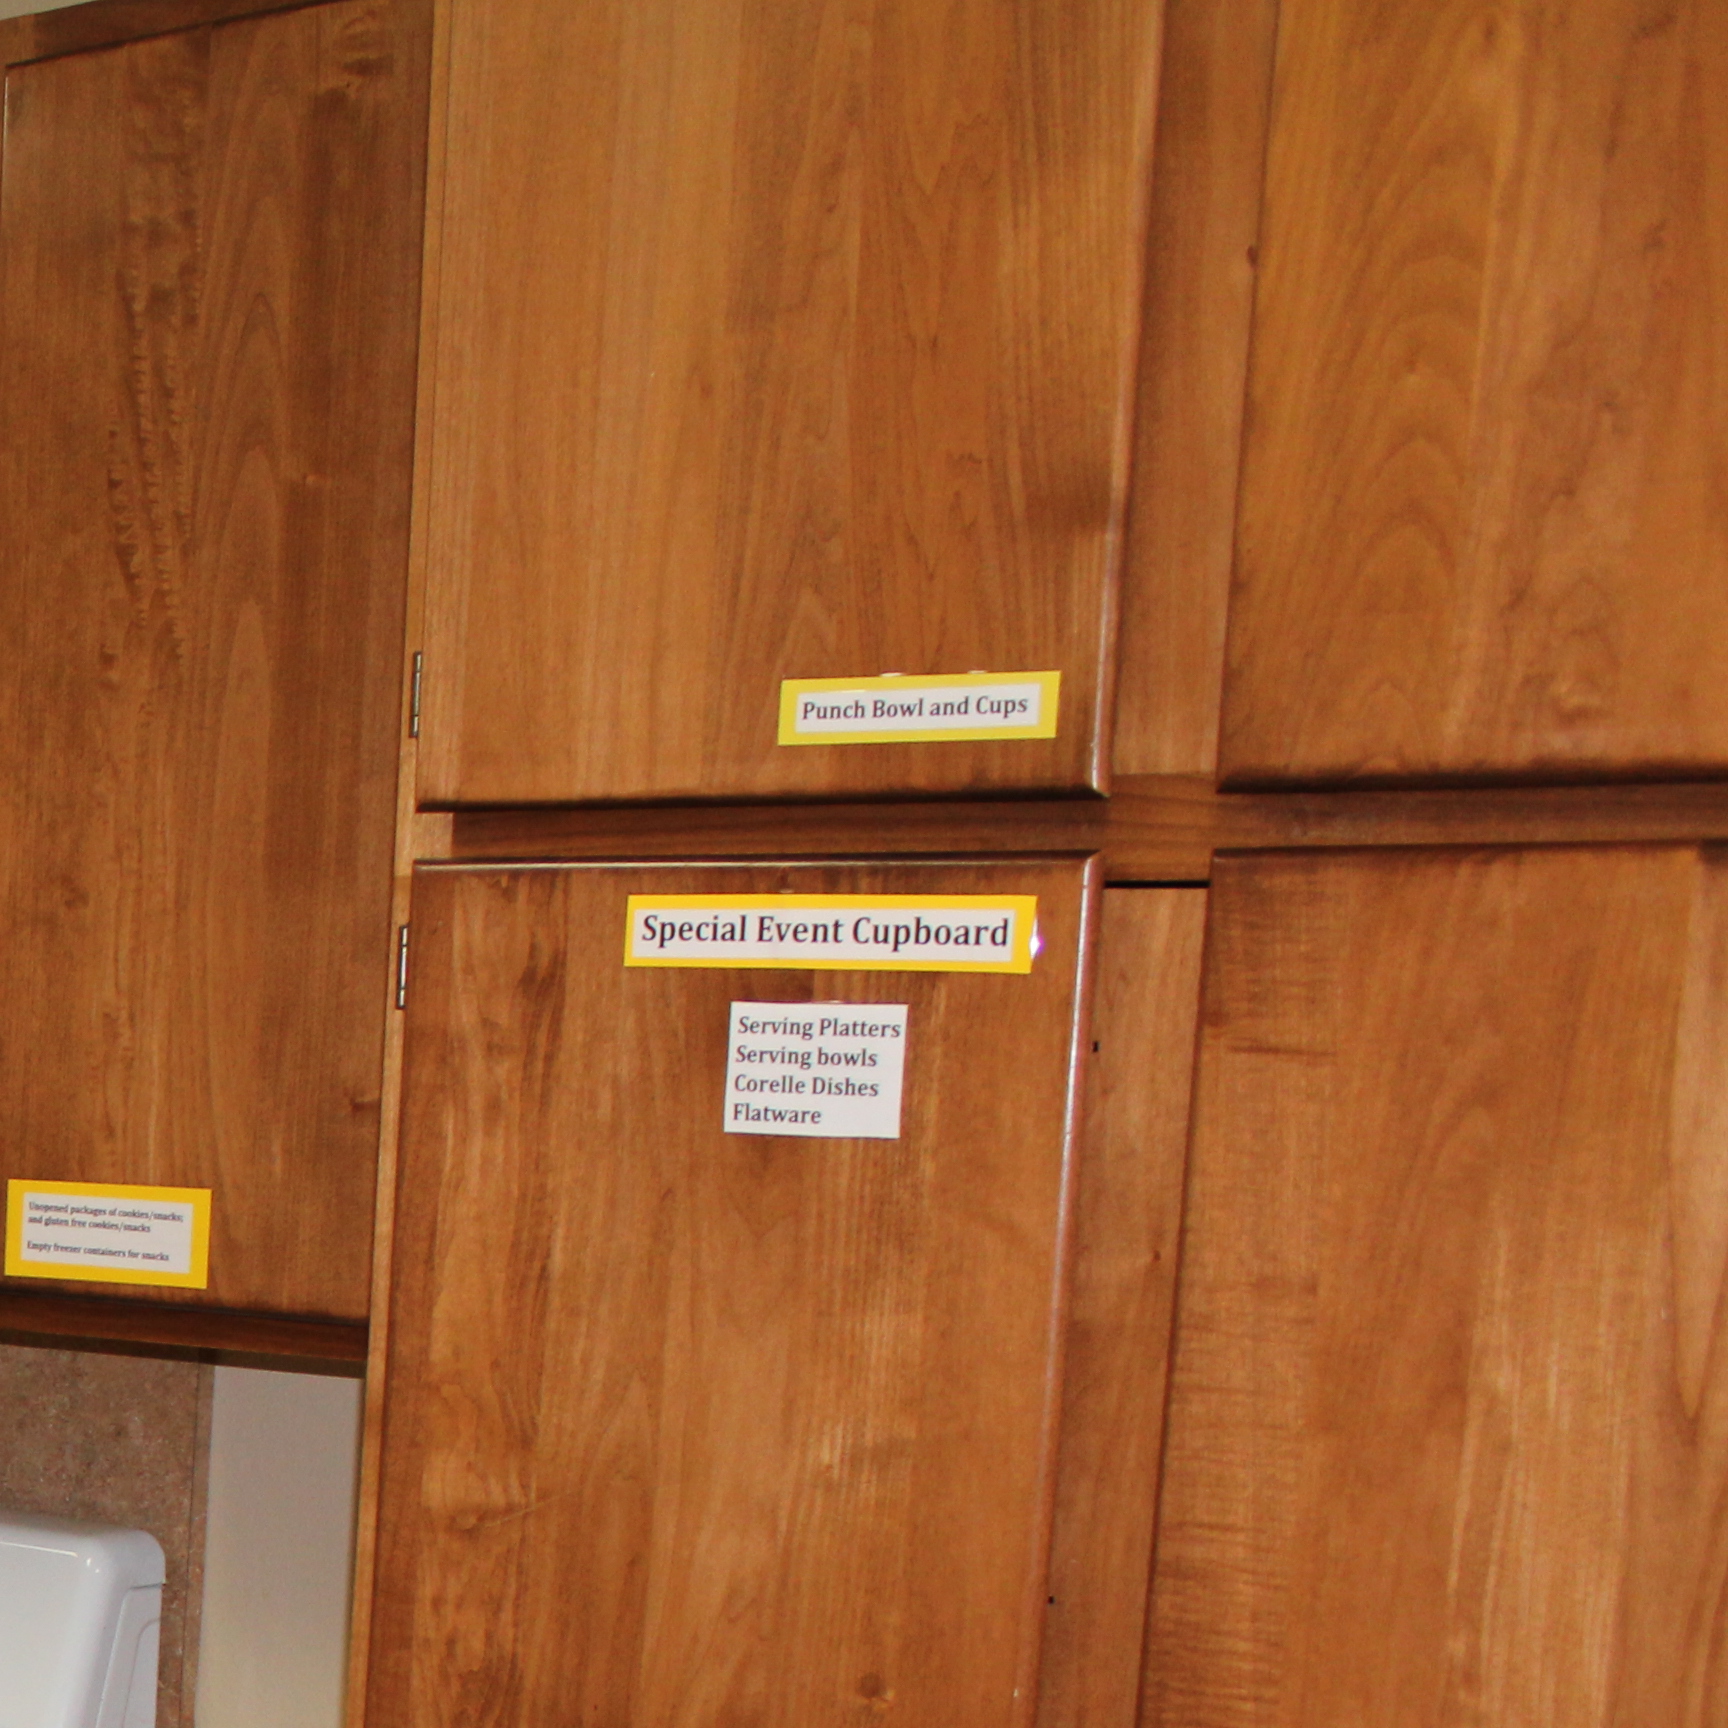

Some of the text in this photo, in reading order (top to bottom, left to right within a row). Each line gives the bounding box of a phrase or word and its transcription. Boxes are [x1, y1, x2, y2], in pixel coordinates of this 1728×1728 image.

[802, 695, 1029, 720] Punch Bowl and Cups
[642, 915, 1009, 952] Special Event Cupboard
[738, 1016, 902, 1040] Serving Platters
[735, 1045, 878, 1070] Serving bowls
[734, 1074, 879, 1097] Corelle Dishes
[733, 1103, 822, 1124] Flatware
[29, 1201, 69, 1213] Unopened
[70, 1205, 106, 1217] packages
[108, 1207, 118, 1216] of
[28, 1215, 151, 1233] and gluten free cookies/snacks
[27, 1240, 170, 1261] Empty freezer containers for snacks
